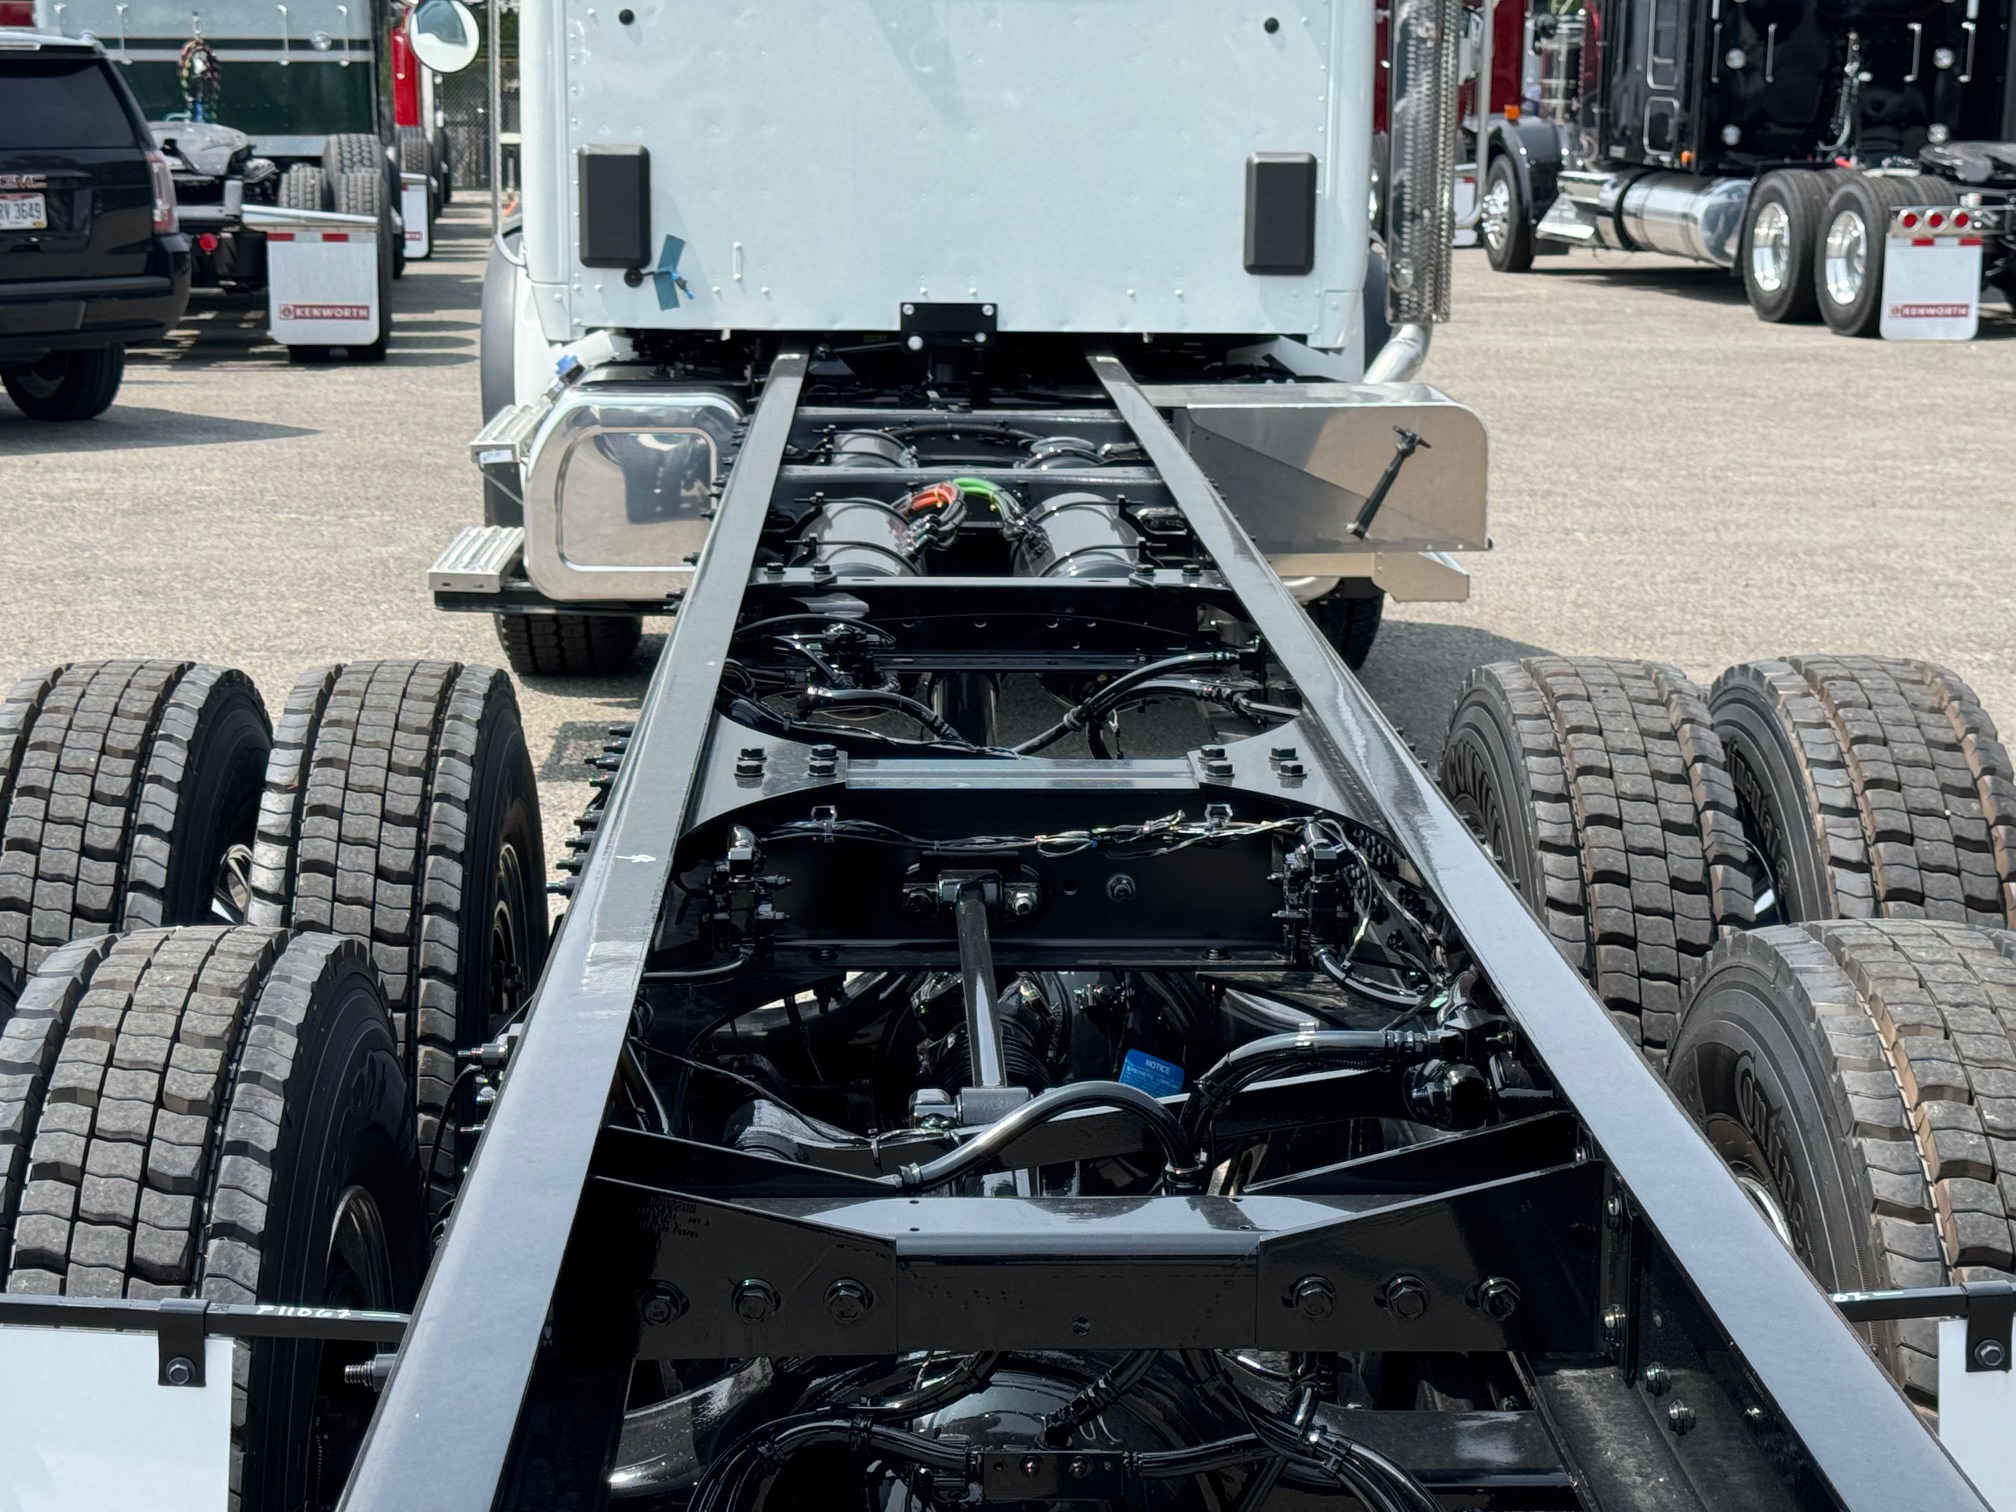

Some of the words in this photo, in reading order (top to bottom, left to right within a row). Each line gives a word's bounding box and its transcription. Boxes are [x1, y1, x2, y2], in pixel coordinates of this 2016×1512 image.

[14, 202, 42, 220] 3649
[295, 307, 369, 318] KENWORTH
[1144, 1058, 1171, 1075] NOTICE
